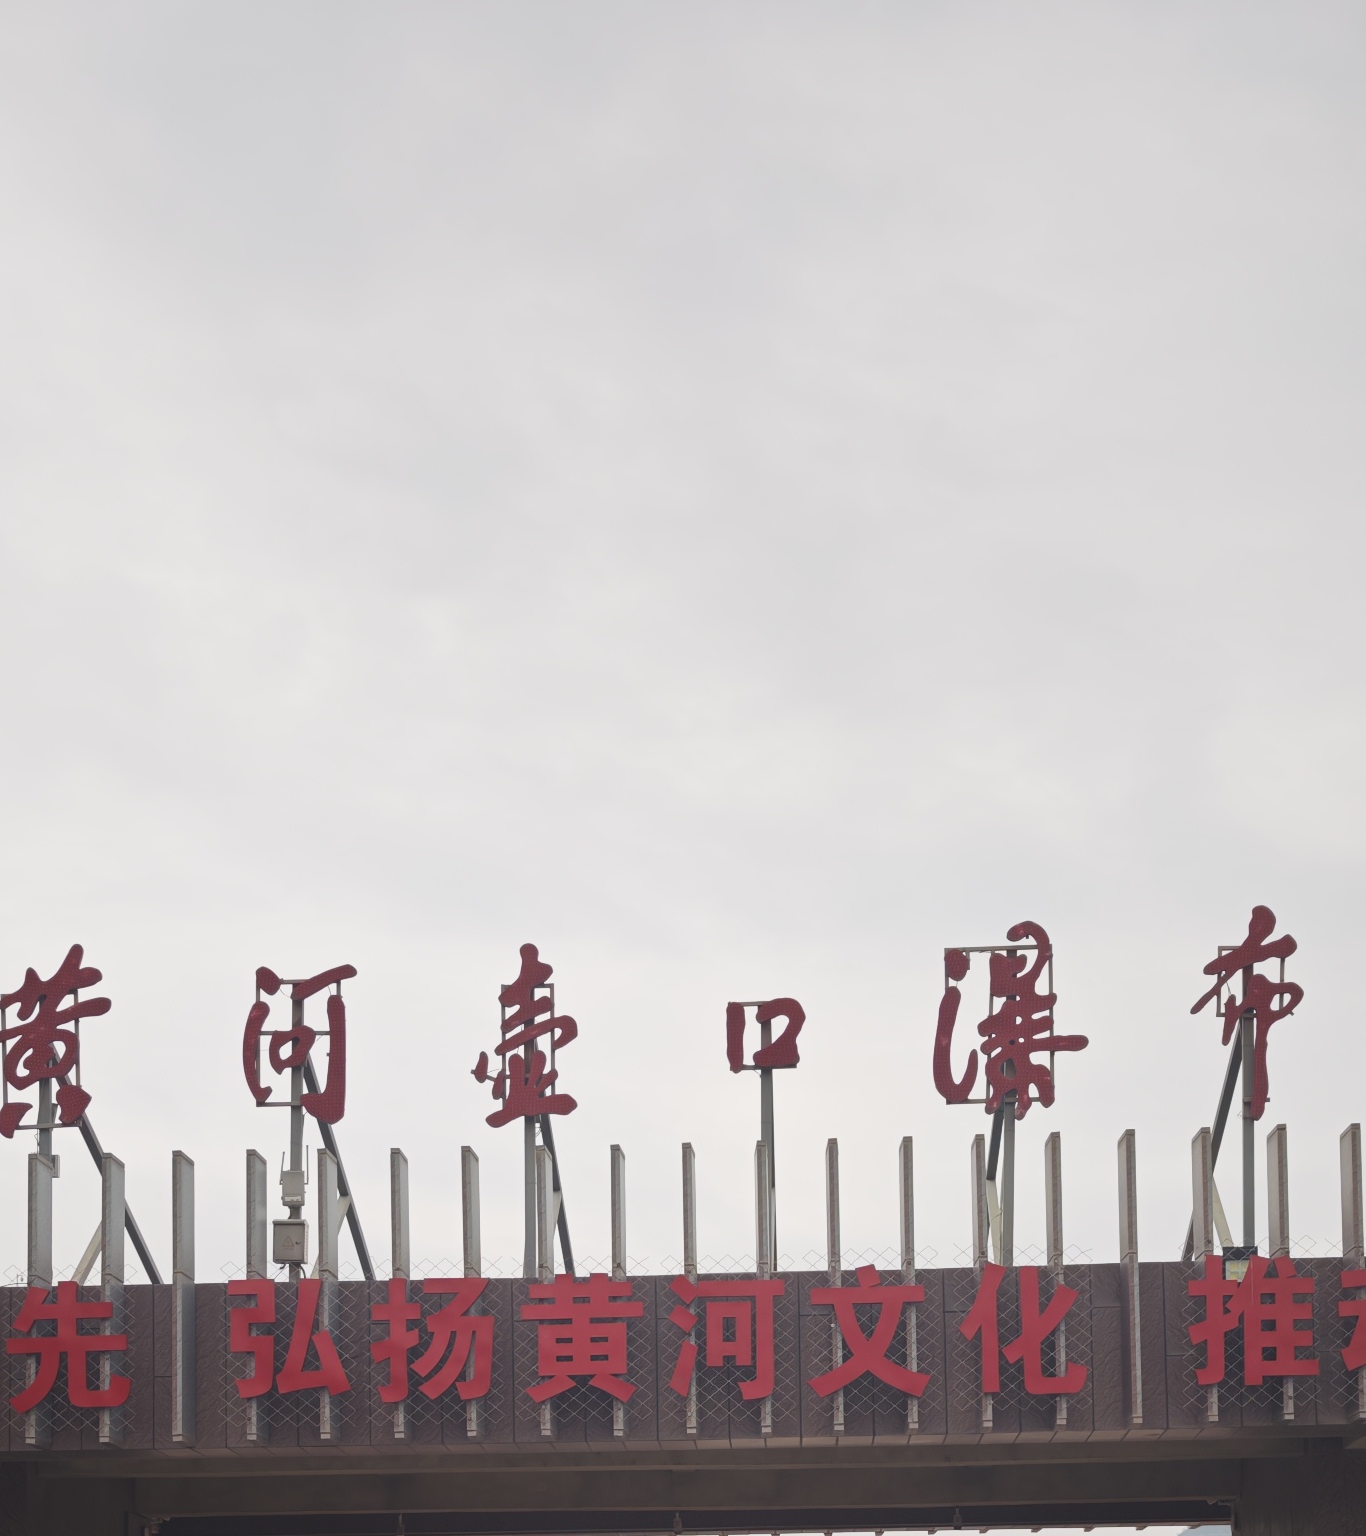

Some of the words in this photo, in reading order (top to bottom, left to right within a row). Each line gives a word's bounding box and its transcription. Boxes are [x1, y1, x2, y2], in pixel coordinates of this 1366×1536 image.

[227, 1264, 1088, 1404] 弘扬黄河文化
